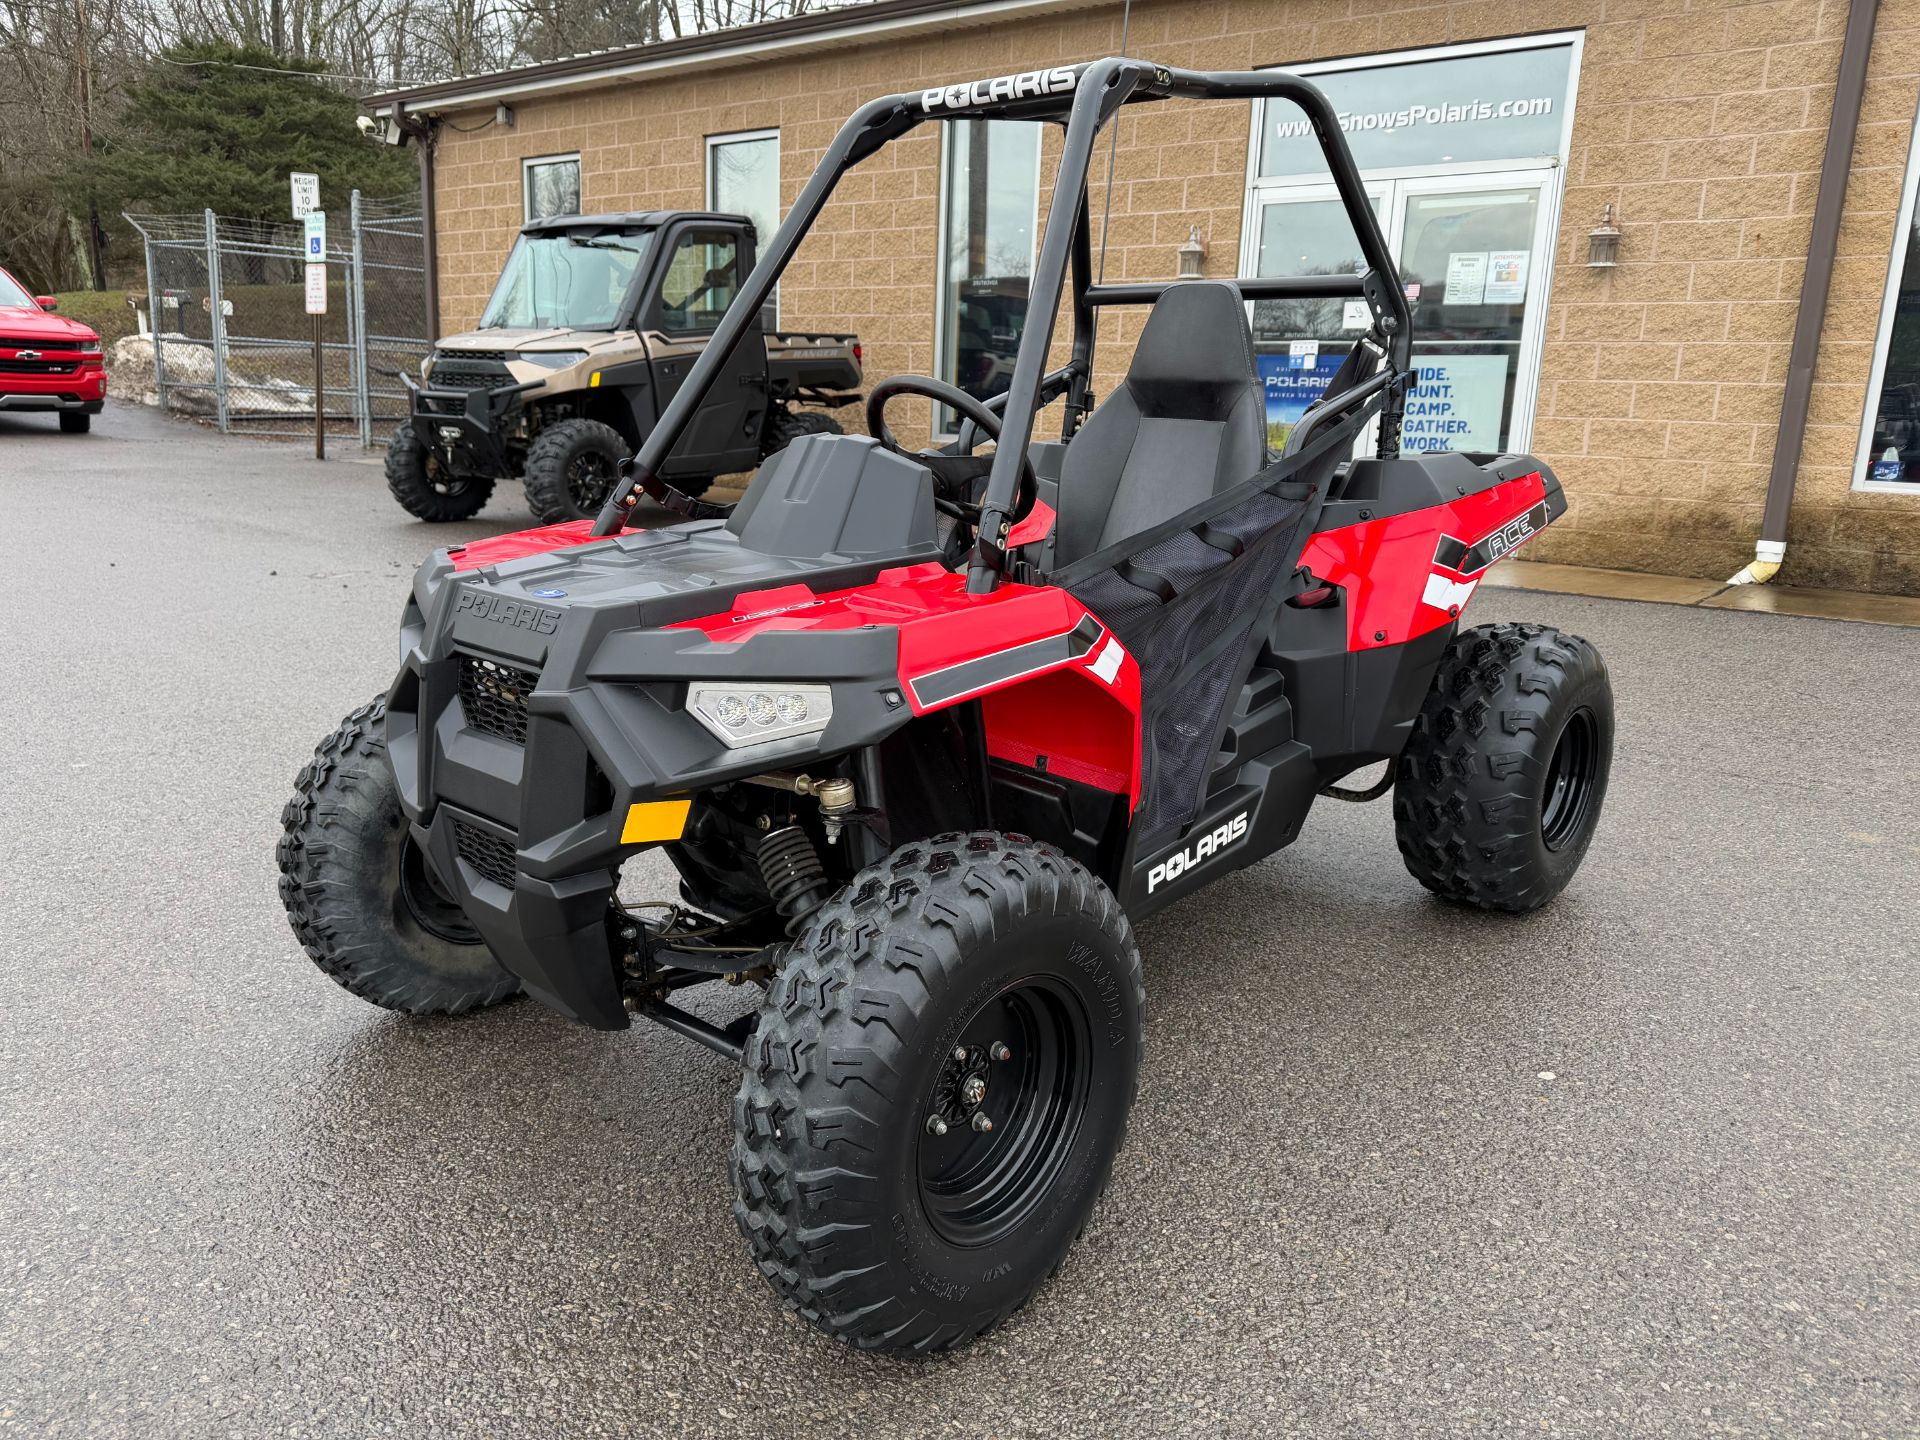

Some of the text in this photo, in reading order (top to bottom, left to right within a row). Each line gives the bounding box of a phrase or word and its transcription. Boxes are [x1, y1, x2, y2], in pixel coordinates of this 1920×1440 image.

[921, 64, 1076, 113] POLARIS
[1276, 97, 1553, 138] wwSnowsPolaris.com
[294, 177, 315, 186] WEIGHT
[297, 186, 313, 194] LIMIT
[302, 196, 311, 206] 10
[1495, 261, 1521, 270] FedEx
[1411, 367, 1450, 381] IDE.
[1407, 385, 1454, 399] HUNT.
[1406, 402, 1455, 416] CAMP.
[1404, 420, 1471, 434] GATHER.
[1403, 436, 1454, 450] WORK.
[1488, 513, 1535, 559] ACE
[456, 590, 562, 635] POLARIS
[1148, 811, 1248, 894] POLARIS
